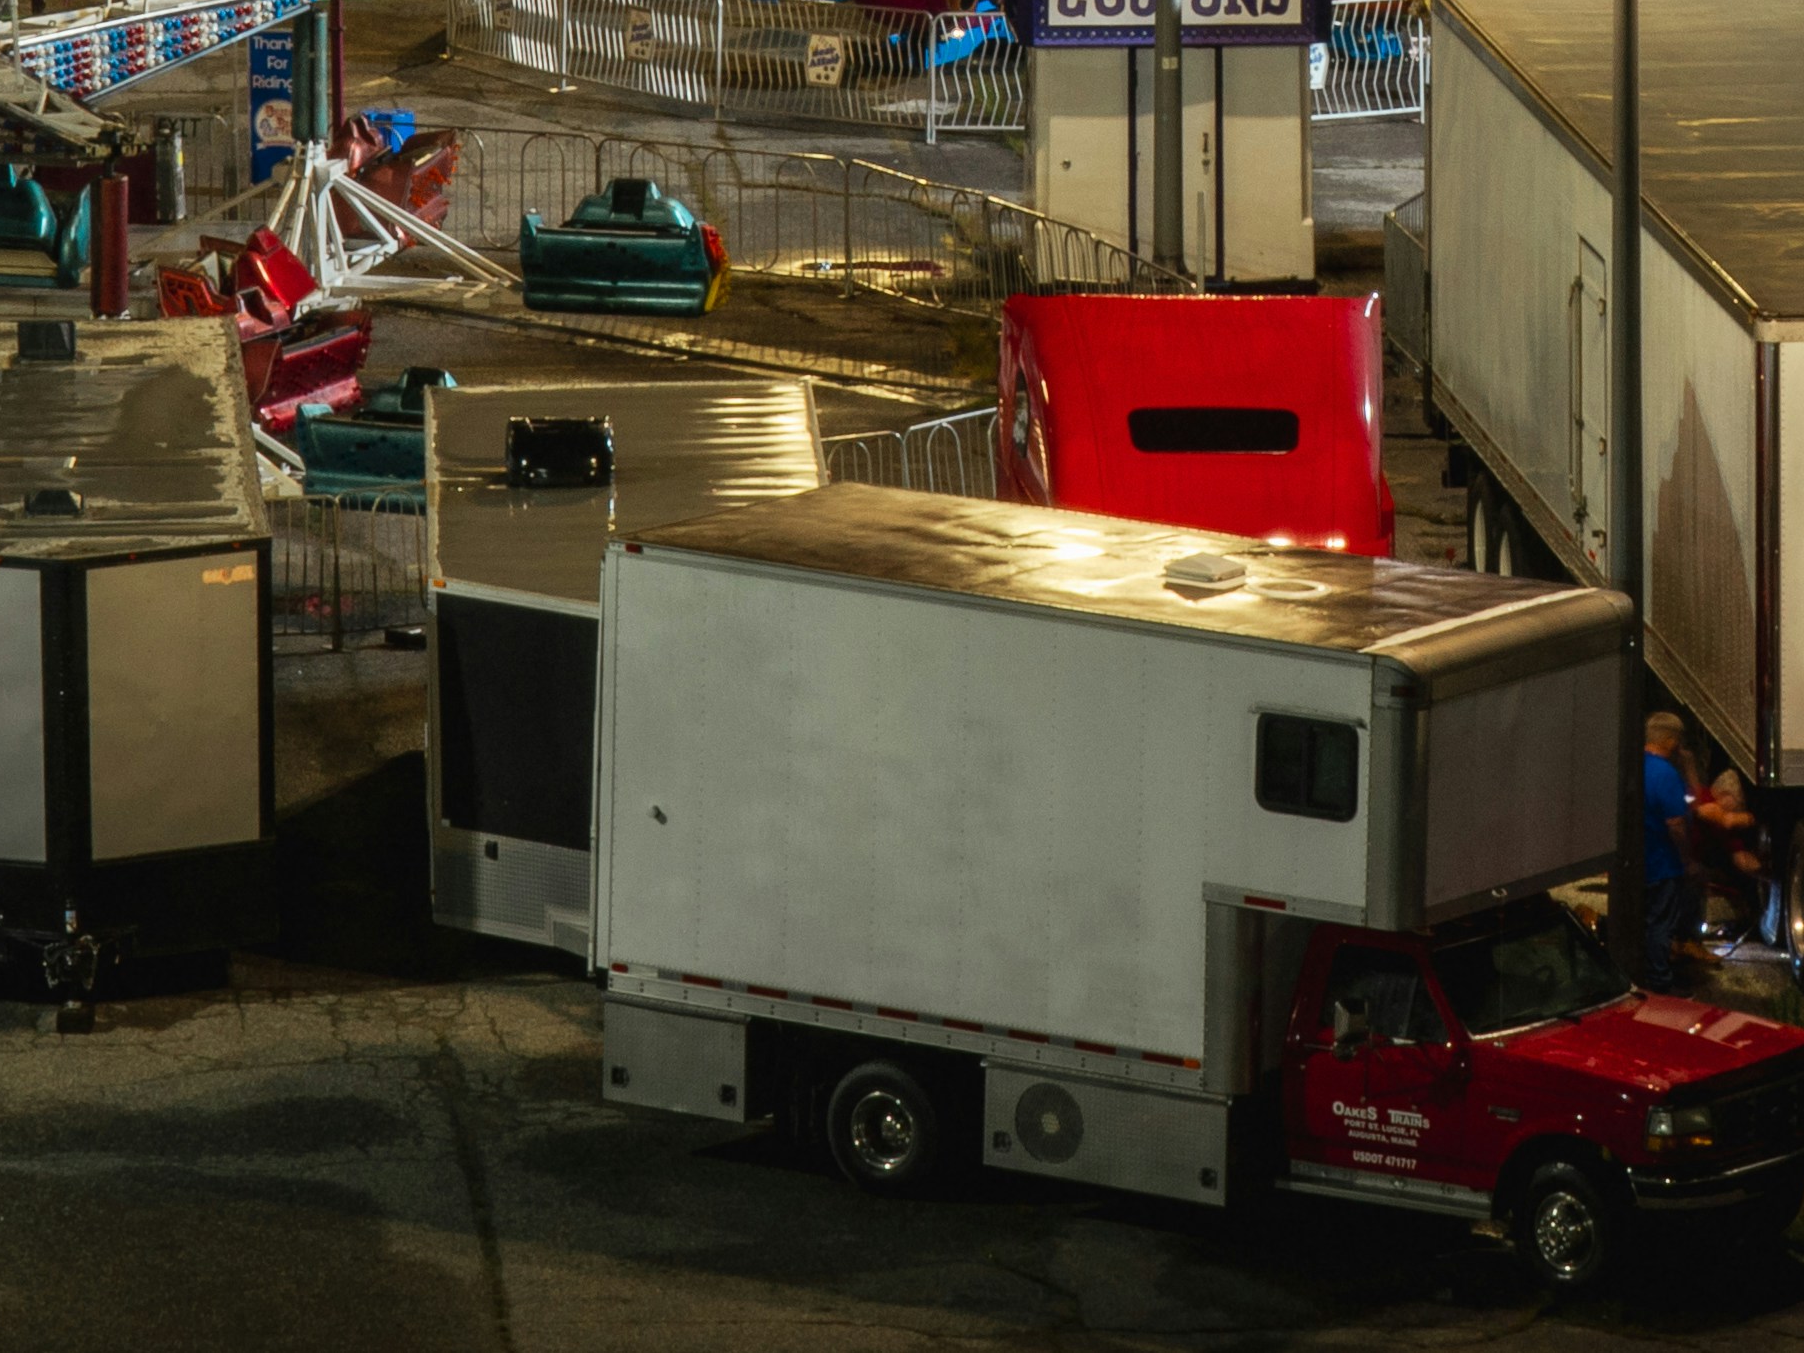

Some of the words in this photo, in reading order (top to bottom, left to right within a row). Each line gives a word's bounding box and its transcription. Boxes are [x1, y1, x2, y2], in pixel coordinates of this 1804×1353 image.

[267, 55, 289, 71] For
[252, 75, 294, 94] Riding
[1352, 1149, 1384, 1165] USDOT
[1385, 1155, 1417, 1171] 471717
